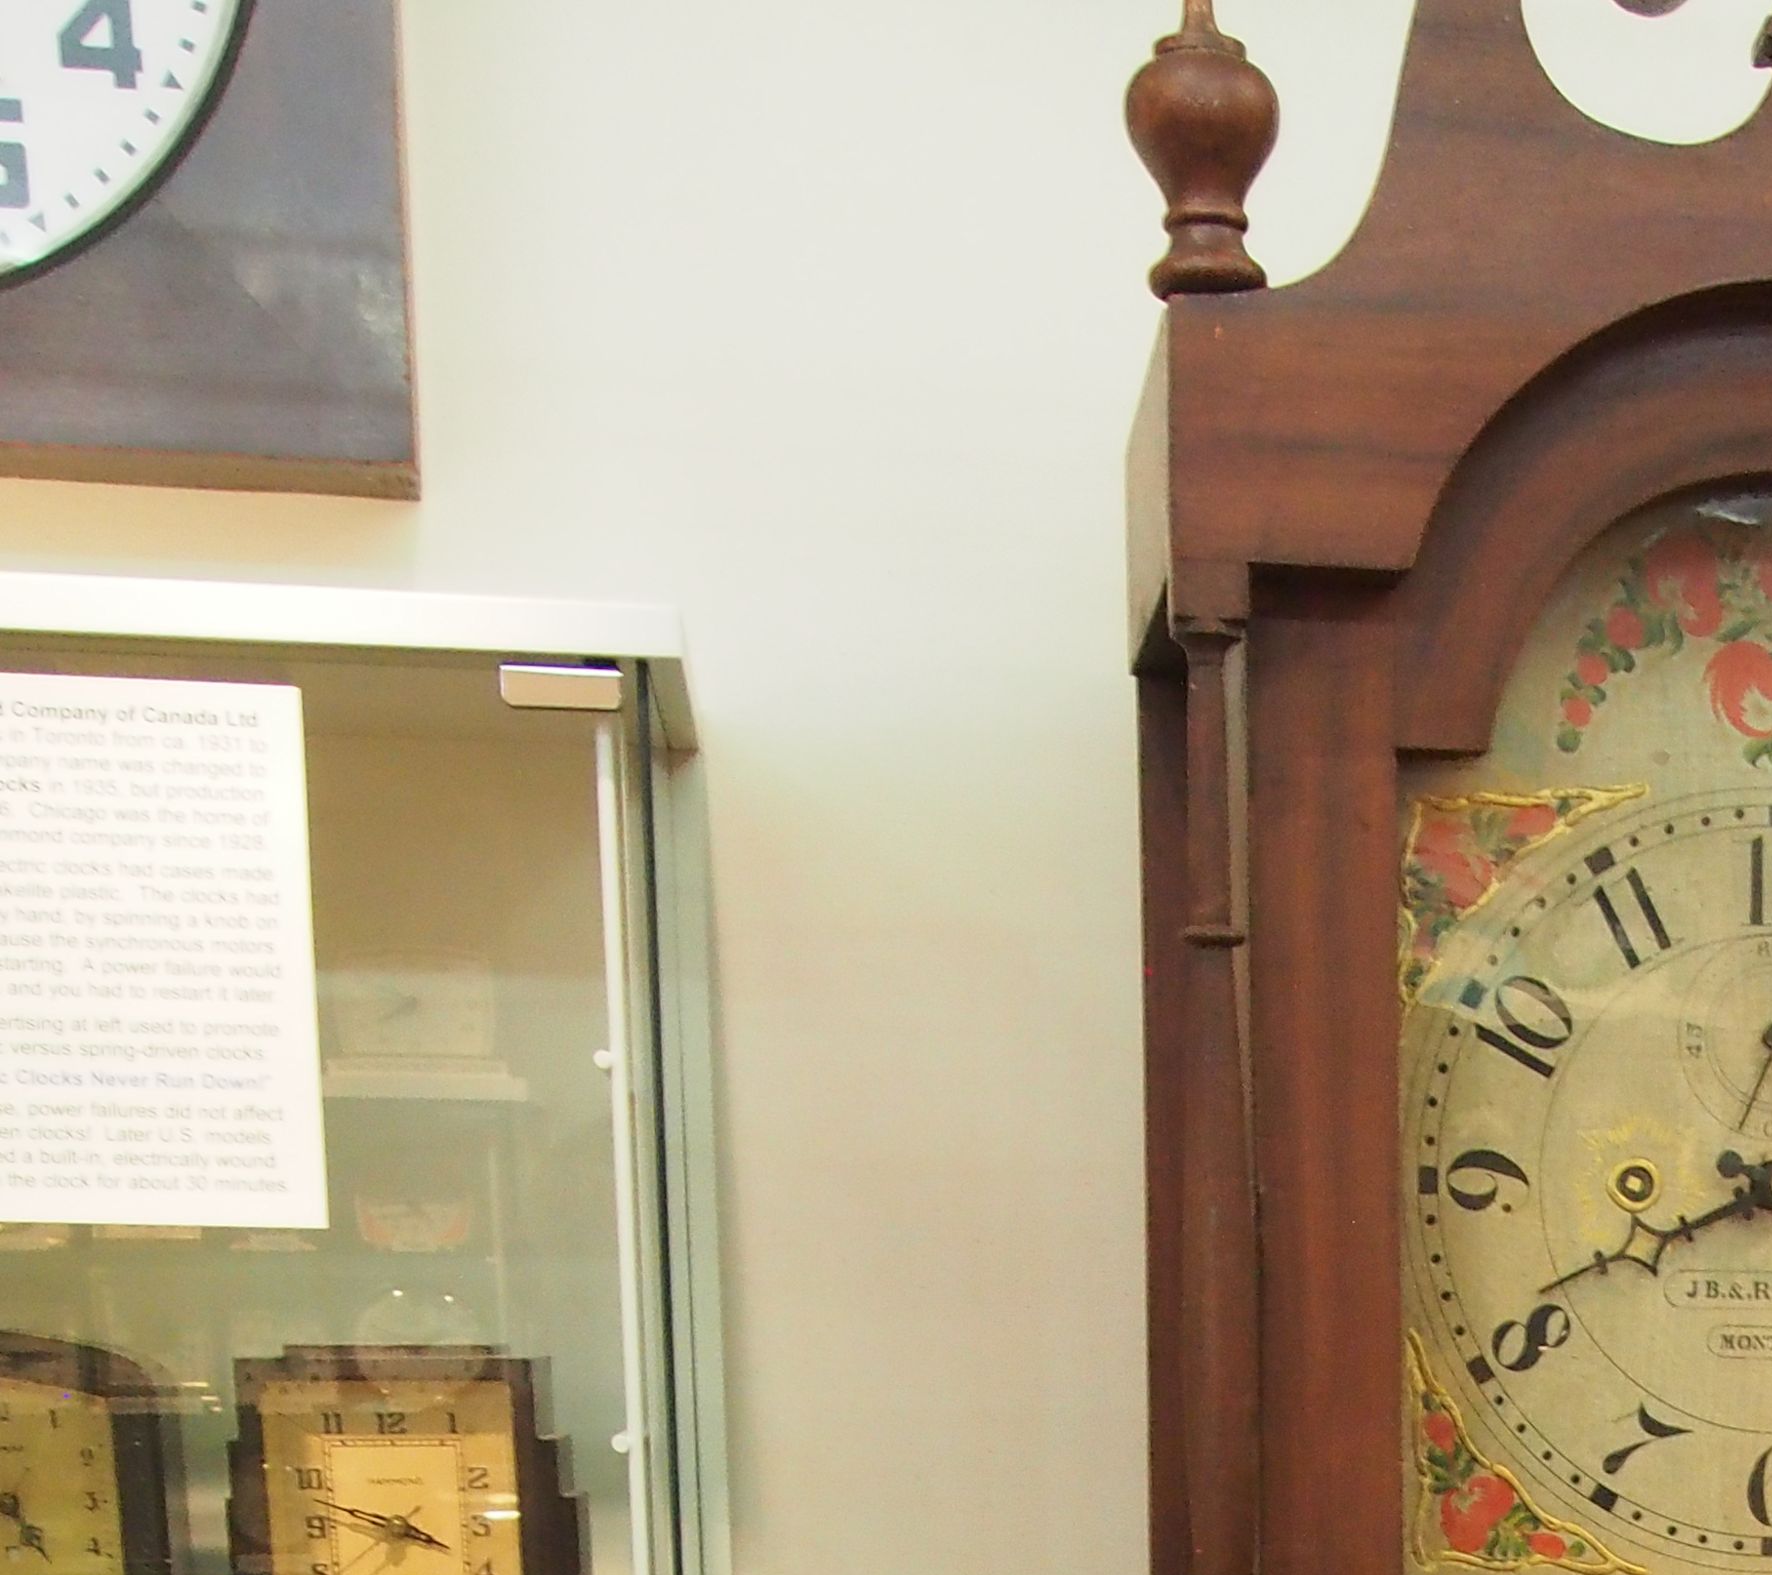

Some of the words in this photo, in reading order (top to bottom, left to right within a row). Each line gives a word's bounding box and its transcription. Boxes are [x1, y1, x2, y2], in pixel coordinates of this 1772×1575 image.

[57, 0, 143, 89] 4
[1594, 868, 1682, 969] 11
[1476, 975, 1573, 1077] 10
[1447, 1149, 1529, 1214] 9
[1491, 1304, 1571, 1371] 8
[321, 1412, 343, 1434] 11
[376, 1411, 407, 1434] 12
[446, 1412, 458, 1433] 1
[1604, 1401, 1693, 1475] 7
[296, 1468, 325, 1490] 10
[468, 1467, 488, 1489] 2
[306, 1516, 327, 1538] 9
